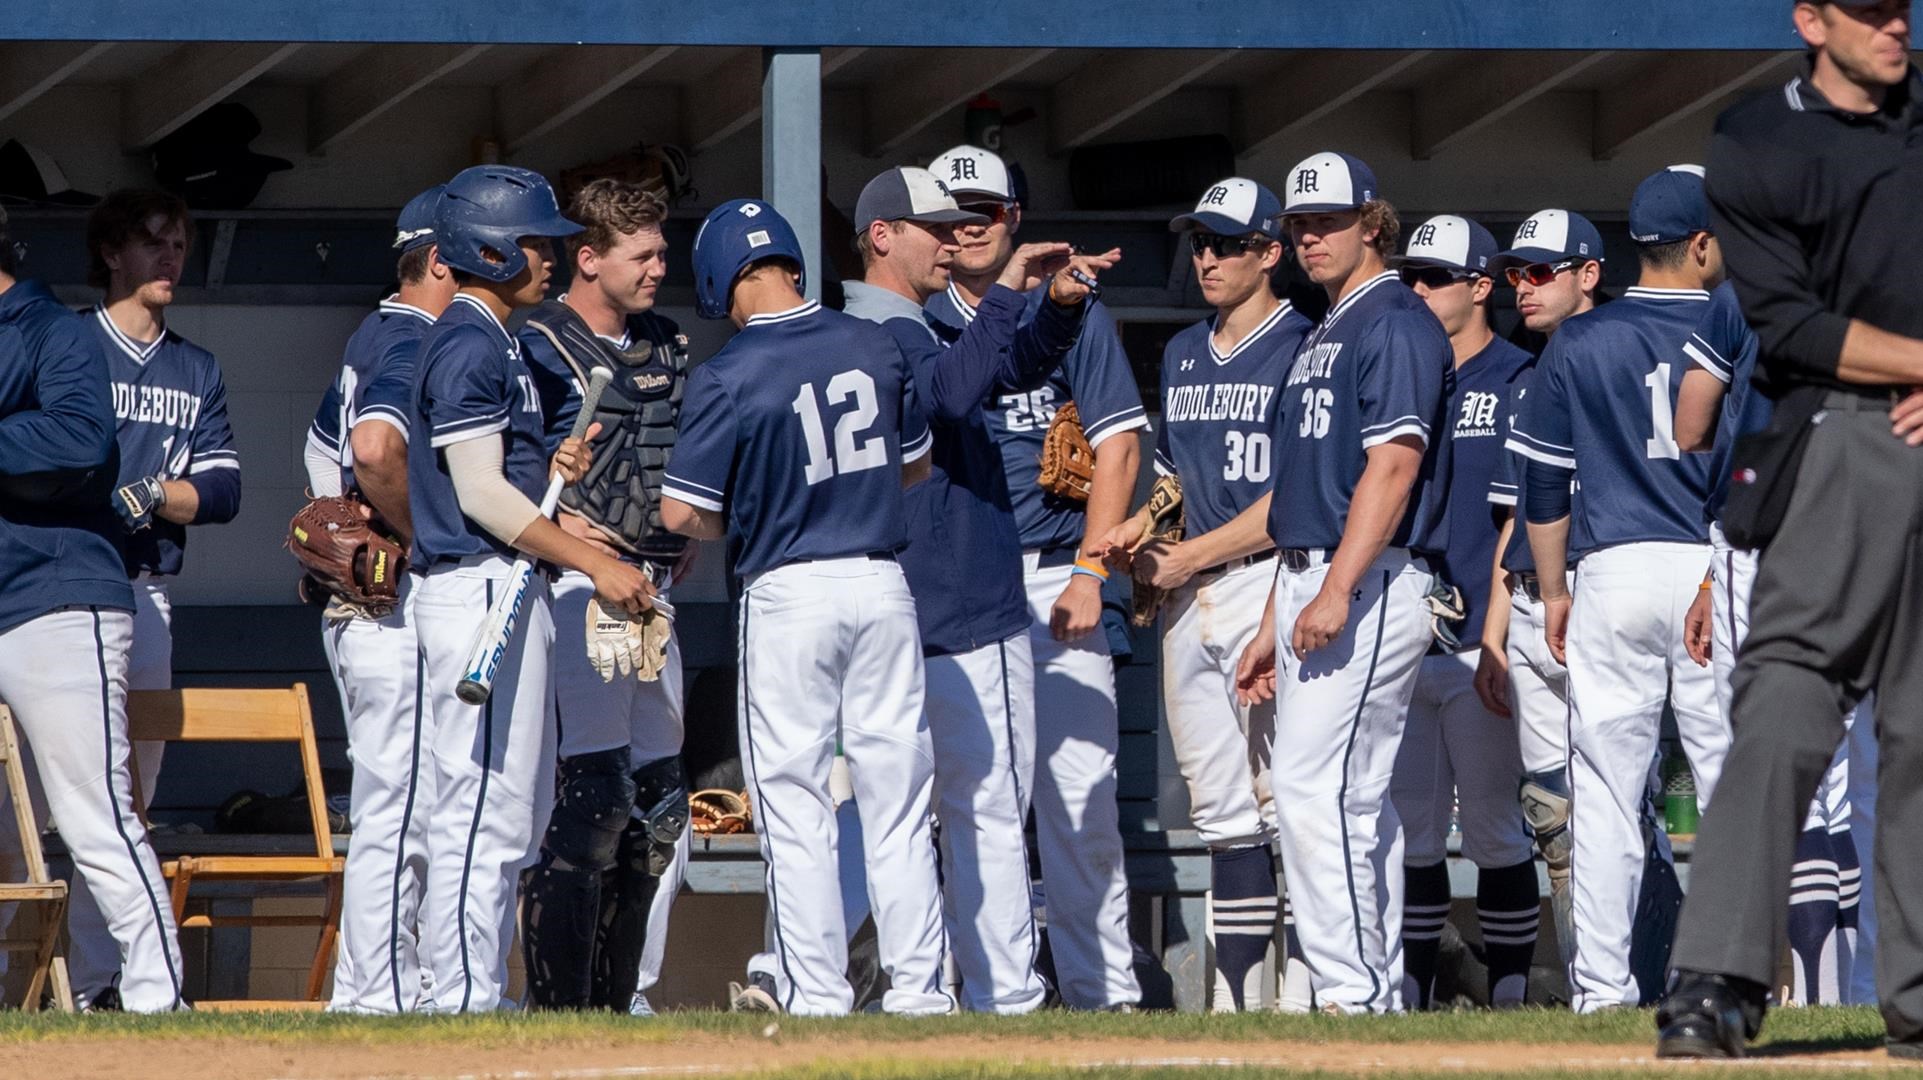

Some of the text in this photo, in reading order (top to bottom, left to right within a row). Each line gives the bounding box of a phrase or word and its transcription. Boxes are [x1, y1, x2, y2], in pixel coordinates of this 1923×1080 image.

[633, 374, 670, 390] Wilson
[1167, 384, 1274, 423] MIDDLEBURY
[111, 382, 200, 431] DLEBURY
[792, 368, 888, 486] 12
[1002, 386, 1056, 432] 26
[1300, 388, 1334, 439] 36
[1645, 363, 1680, 460] 1
[1224, 430, 1271, 482] 30
[1453, 428, 1497, 438] BASEBALL
[157, 435, 190, 481] 14
[373, 550, 387, 584] Wilson
